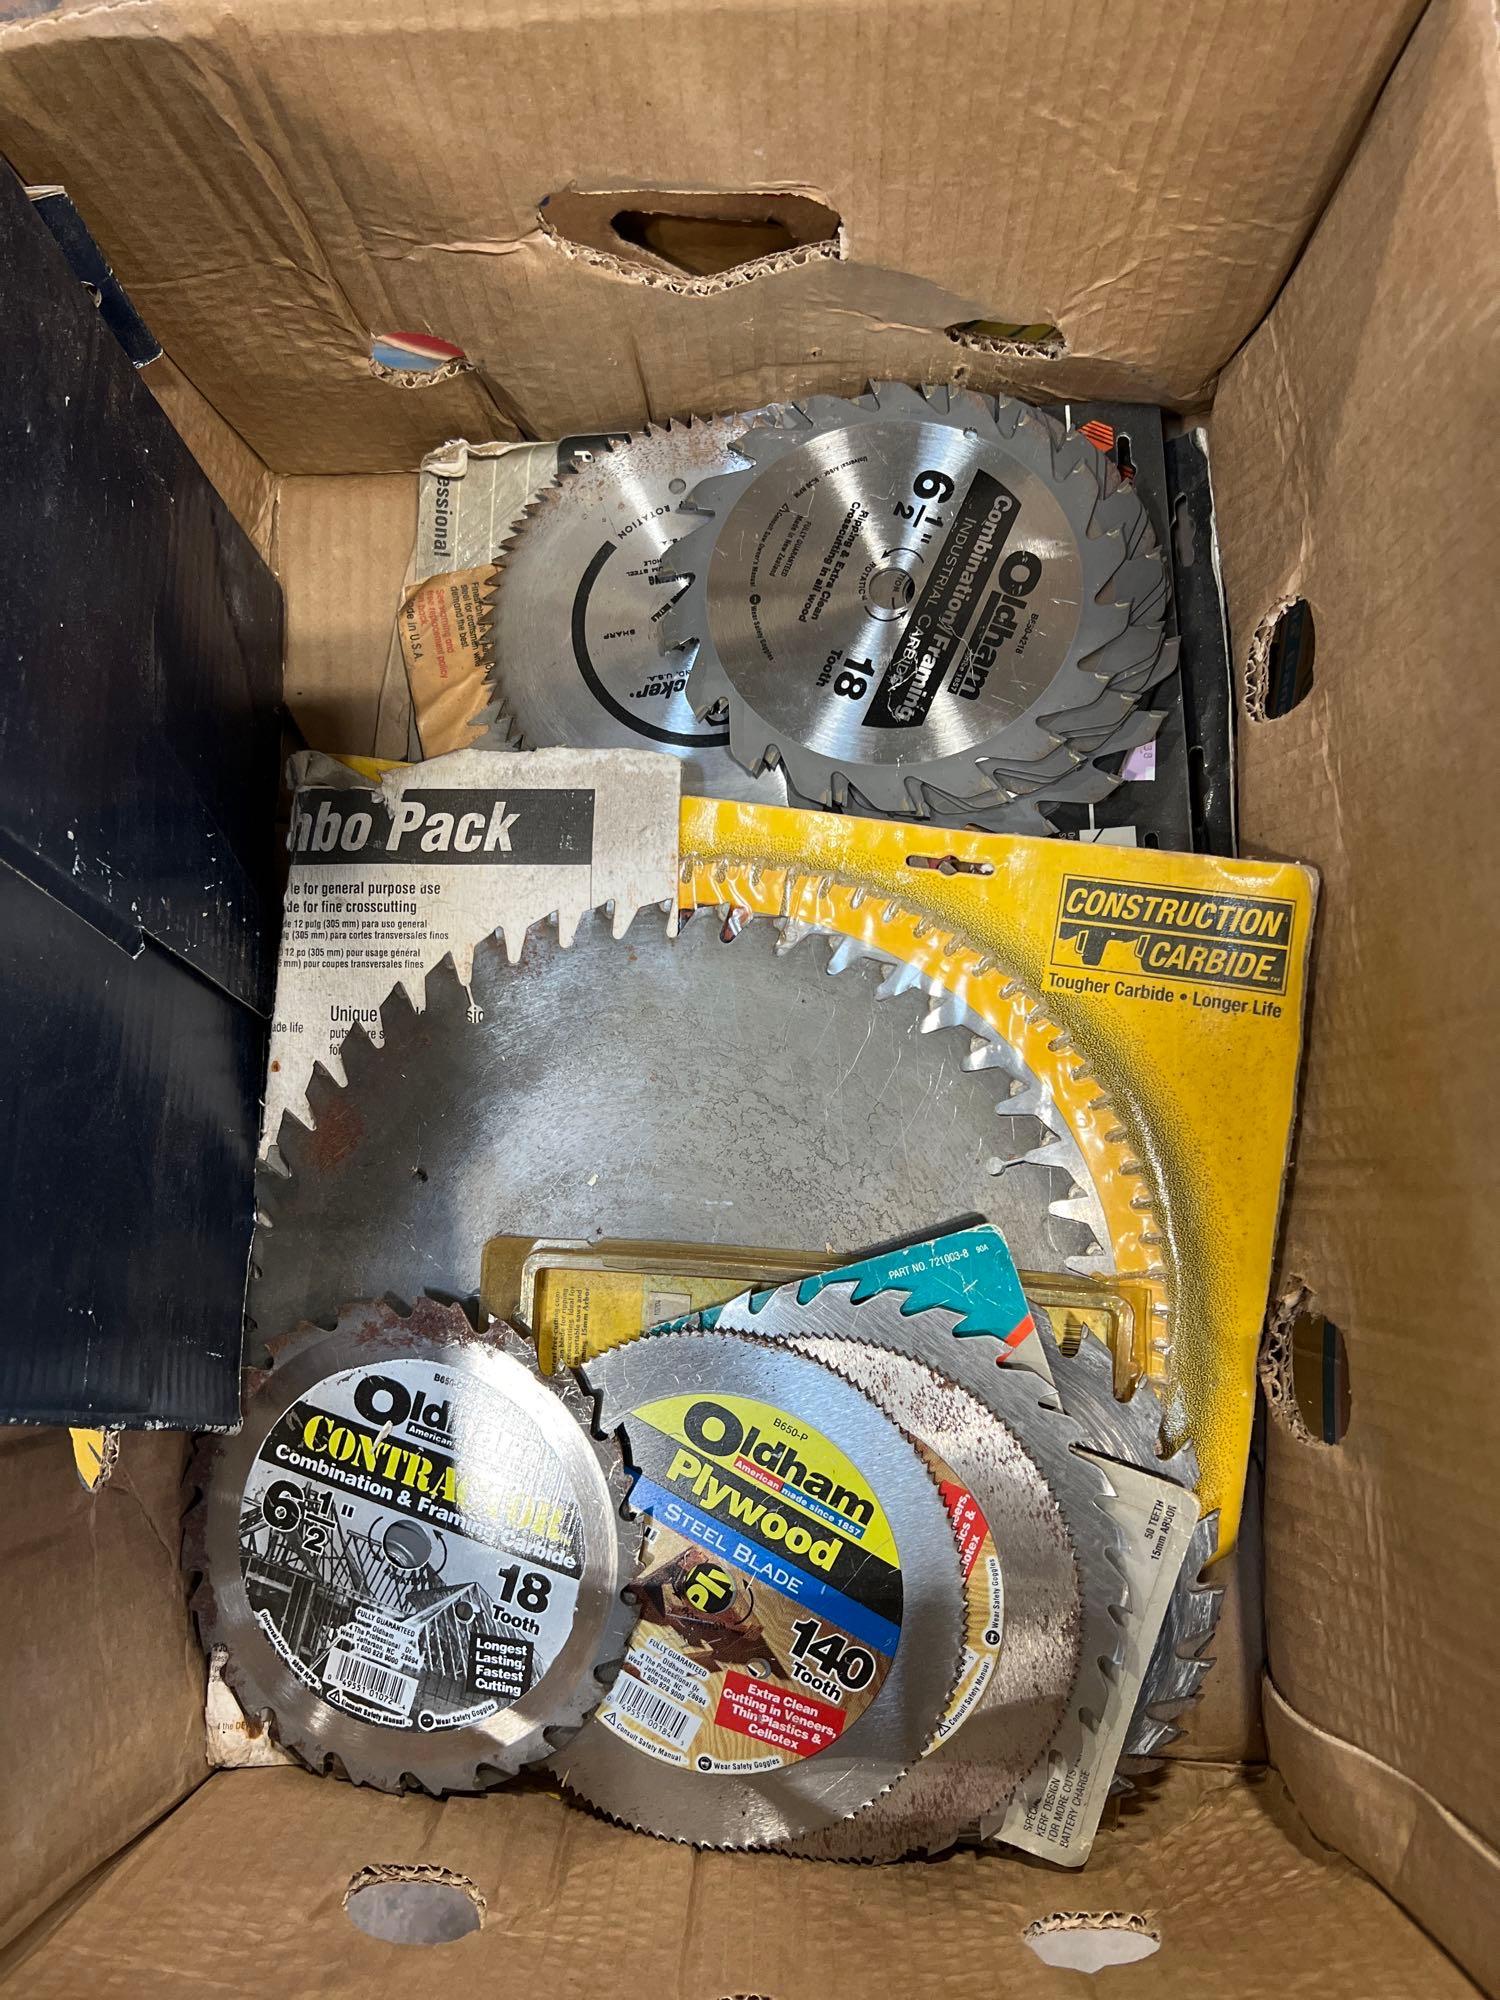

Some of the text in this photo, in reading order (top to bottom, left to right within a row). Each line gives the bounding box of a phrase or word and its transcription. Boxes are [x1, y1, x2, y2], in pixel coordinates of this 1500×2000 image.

[913, 469, 955, 505] 6
[617, 504, 671, 540] ROTATION
[843, 509, 870, 549] Ripping
[798, 501, 861, 623] Crosscutting all wood
[825, 561, 845, 593] Extra
[923, 516, 977, 608] INDUSTRIAL
[811, 591, 831, 621] Clean
[407, 622, 416, 632] in
[603, 628, 636, 640] SHARP
[958, 549, 1043, 701] Oldham
[815, 649, 843, 687] Tooth
[833, 657, 875, 701] 18
[386, 801, 521, 853] Pack
[304, 882, 416, 897] for general purpose
[294, 920, 303, 928] 12
[323, 919, 341, 929] (305
[342, 920, 360, 929] mm)
[362, 921, 379, 930] para
[397, 920, 428, 930] general
[303, 901, 417, 915] for fine crosscutting
[1066, 887, 1284, 938] CONSTRUCTION
[286, 948, 295, 957] 12
[308, 948, 325, 958] (305
[327, 948, 344, 958] mm)
[346, 950, 363, 958] pour
[365, 950, 388, 958] usage
[390, 948, 420, 958] général
[292, 931, 309, 941] (305
[311, 931, 328, 940] mm)
[330, 932, 347, 941] para
[374, 931, 427, 939] transversales
[429, 931, 449, 939] finos
[284, 960, 301, 969] mm)
[303, 961, 320, 970] pour
[322, 961, 349, 970] coupes
[350, 960, 403, 968] transversales
[405, 960, 424, 969] fines
[1149, 941, 1277, 982] CARBIDE
[1049, 973, 1282, 1018] Tougher Carbide Longer Life
[289, 1023, 304, 1033] life
[330, 1005, 377, 1022] Unique
[888, 1249, 969, 1280] PART NO. 721003-8
[409, 1425, 454, 1447] American
[772, 1416, 809, 1443] B650-P
[274, 1443, 393, 1501] Combination
[397, 1489, 412, 1507] &
[684, 1400, 874, 1526] Oldham
[261, 1479, 306, 1533] 6
[665, 1450, 842, 1572] Plywood
[735, 1460, 861, 1536] American made since 1857
[965, 1510, 976, 1521] &
[1144, 1499, 1164, 1540] 50 TEETH
[664, 1503, 728, 1552] STEEL
[733, 1543, 805, 1595] BLADE
[1150, 1535, 1166, 1561] 15mm
[497, 1563, 552, 1615] 18
[989, 1558, 1001, 1629] Wear Safety Goggles
[356, 1609, 416, 1638] FULLY GUARANTEED
[372, 1625, 395, 1639] Oldham
[492, 1605, 540, 1635] Tooth
[261, 1612, 318, 1685] Universal RPM
[340, 1629, 395, 1656] West NC
[365, 1629, 401, 1650] Professional
[475, 1638, 528, 1655] Longest
[790, 1619, 876, 1691] 140
[475, 1652, 526, 1671] Lasting,
[475, 1666, 524, 1683] Fastest
[628, 1654, 643, 1667] West
[673, 1682, 683, 1691] NC
[645, 1655, 691, 1688] The Professional
[648, 1638, 708, 1678] FULLY GUARANTEED
[662, 1657, 685, 1675] Oldham
[342, 1680, 393, 1705] 49551 01072
[475, 1679, 522, 1697] Cutting
[793, 1661, 842, 1702] Tooth
[948, 1704, 967, 1726] Consult
[964, 1685, 980, 1705] Safety
[975, 1662, 990, 1685] Manual
[435, 1703, 495, 1726] Wear Safety Goggles
[723, 1688, 837, 1739] Cutting in Veneers,
[748, 1683, 819, 1717] Extra Clean
[621, 1704, 672, 1738] 49551 00184
[732, 1704, 822, 1745] Thin Plastics &
[748, 1723, 799, 1750] Cellotex
[617, 1723, 682, 1762] Consult Safety Manual
[714, 1758, 780, 1770] Wear Safety Goggles
[1035, 1777, 1061, 1837] KERF DESIGN
[1047, 1769, 1077, 1843] FOR MORE CUTS
[1060, 1808, 1079, 1848] BATTERY
[1072, 1768, 1091, 1808] CHARGE
